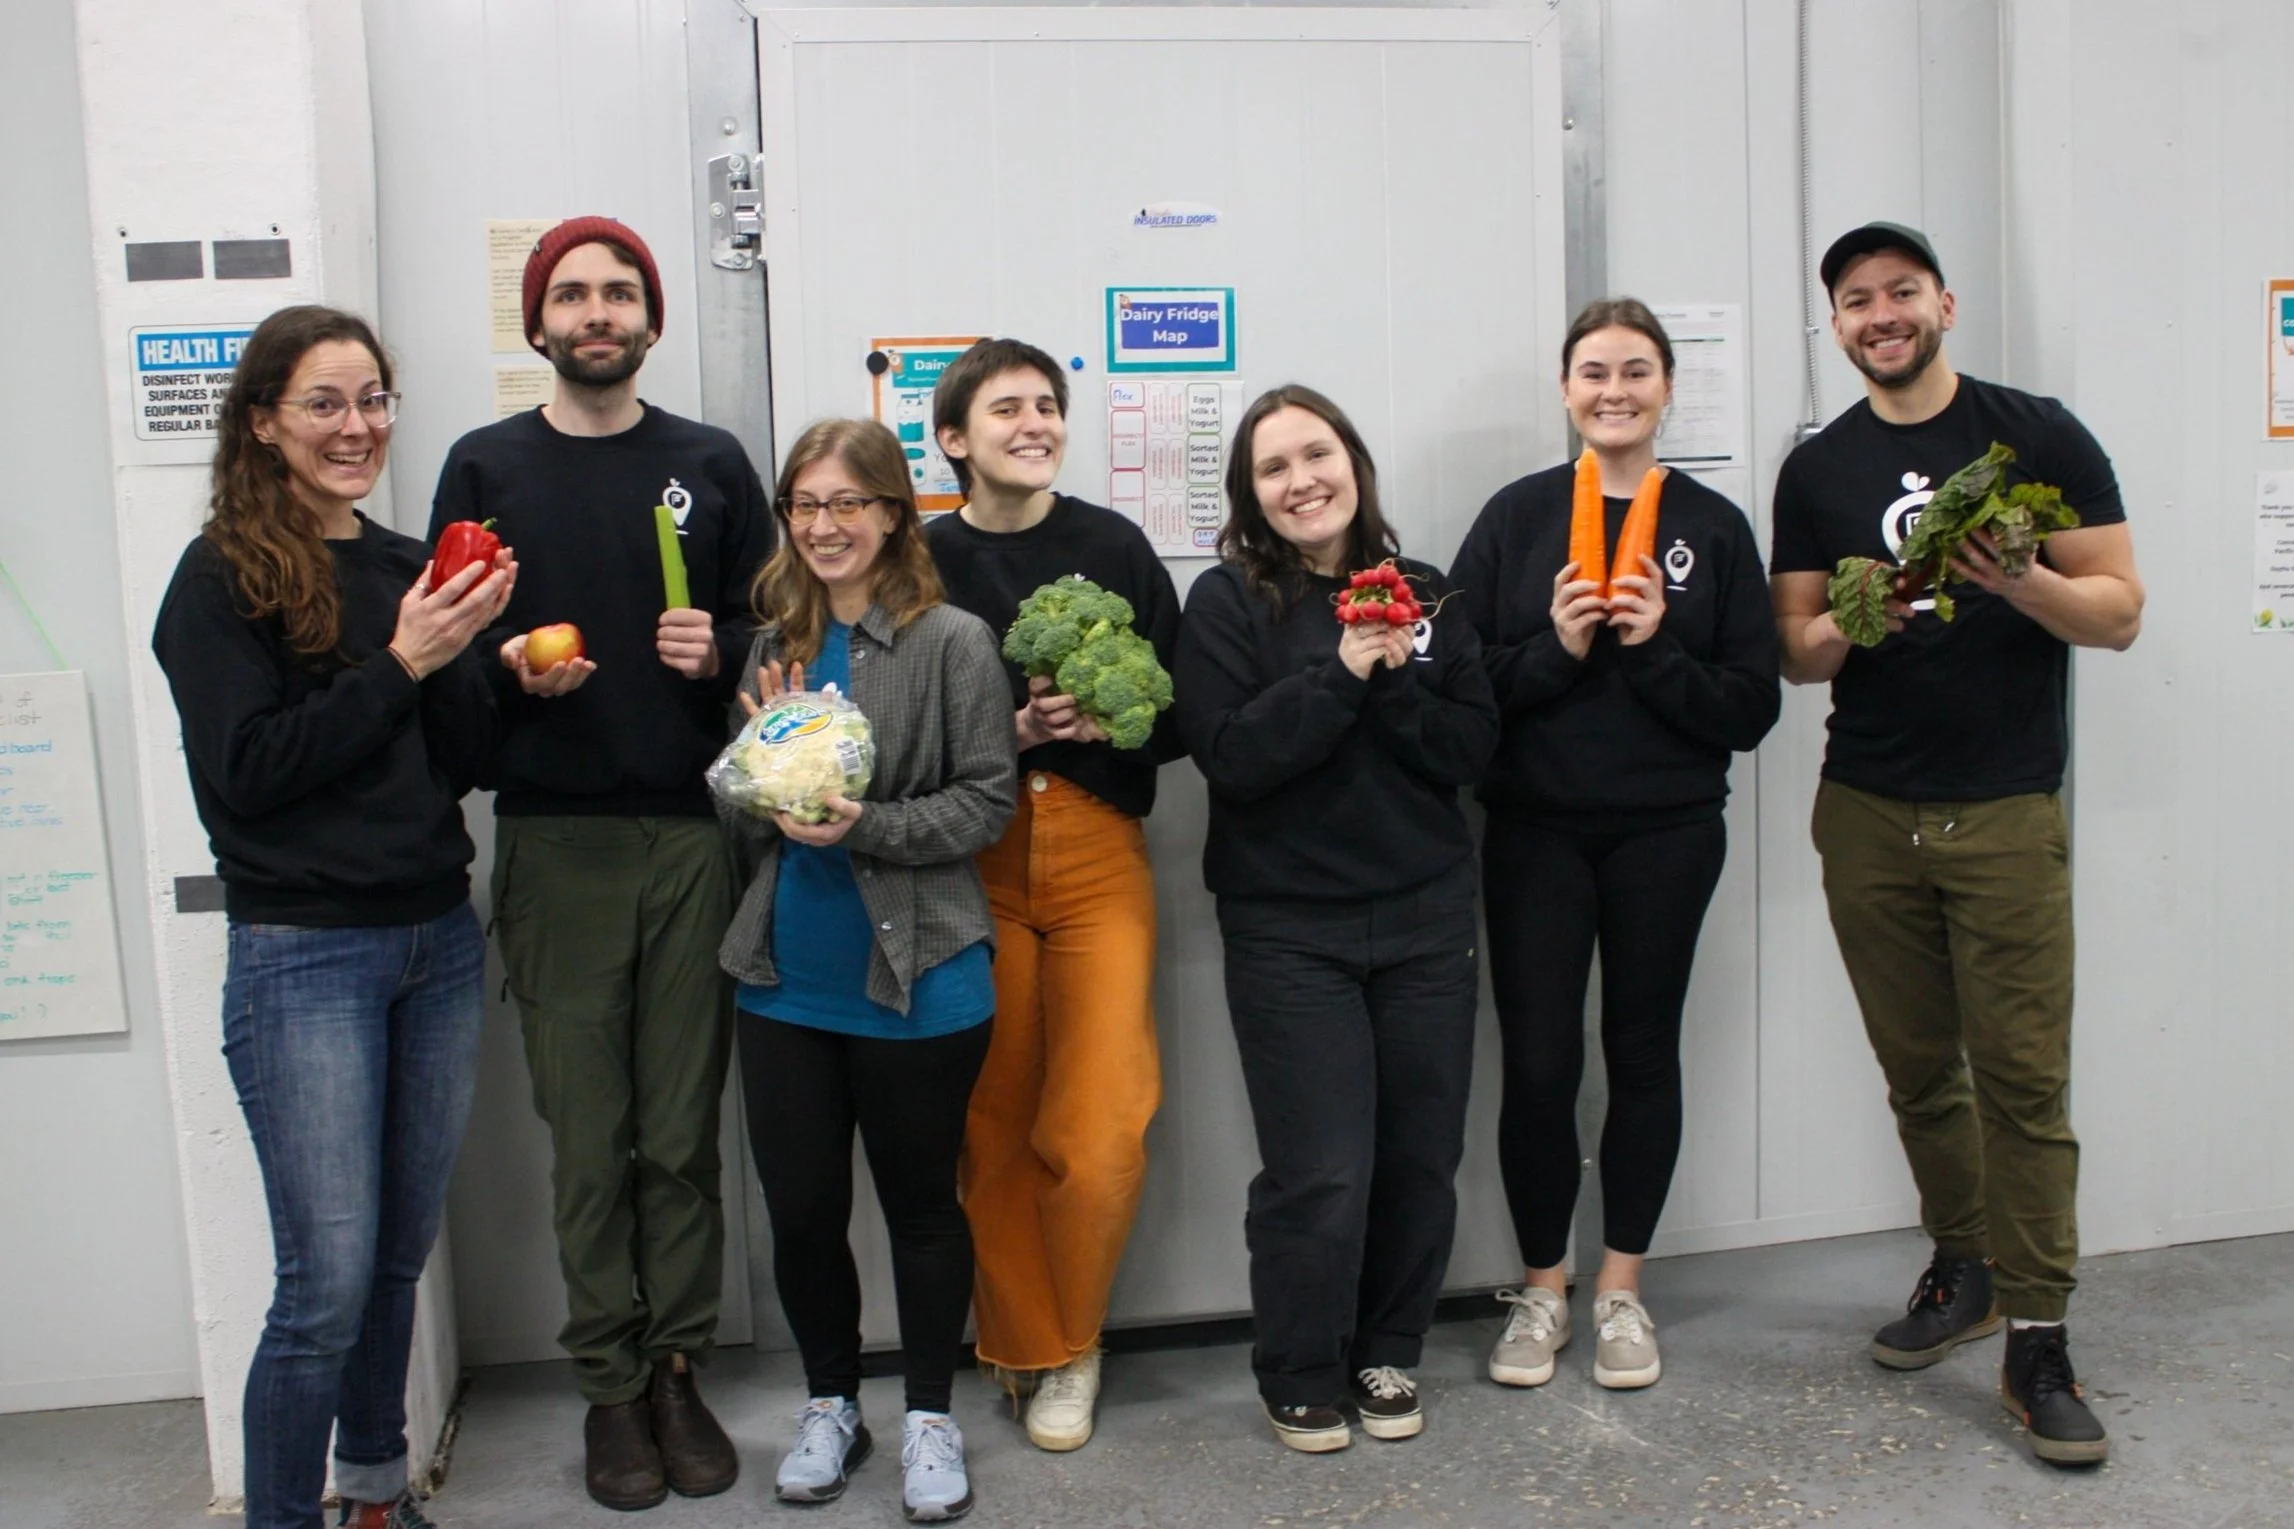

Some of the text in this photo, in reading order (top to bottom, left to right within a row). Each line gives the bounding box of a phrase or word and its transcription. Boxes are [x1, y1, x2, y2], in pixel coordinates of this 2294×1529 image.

[1134, 215, 1217, 226] INSULATED DOORS
[1120, 306, 1219, 324] Dairy Fridge
[1152, 329, 1188, 345] Map
[142, 338, 219, 365] HEALTH
[142, 372, 234, 387] DISINFECT WOR
[148, 389, 207, 402] SURFACES
[1193, 396, 1214, 404] Eggs
[144, 403, 210, 417] EQUIPMENT
[149, 419, 201, 432] REGULAR
[1190, 420, 1219, 428] Yogurt
[1190, 469, 1219, 477] Yogurt
